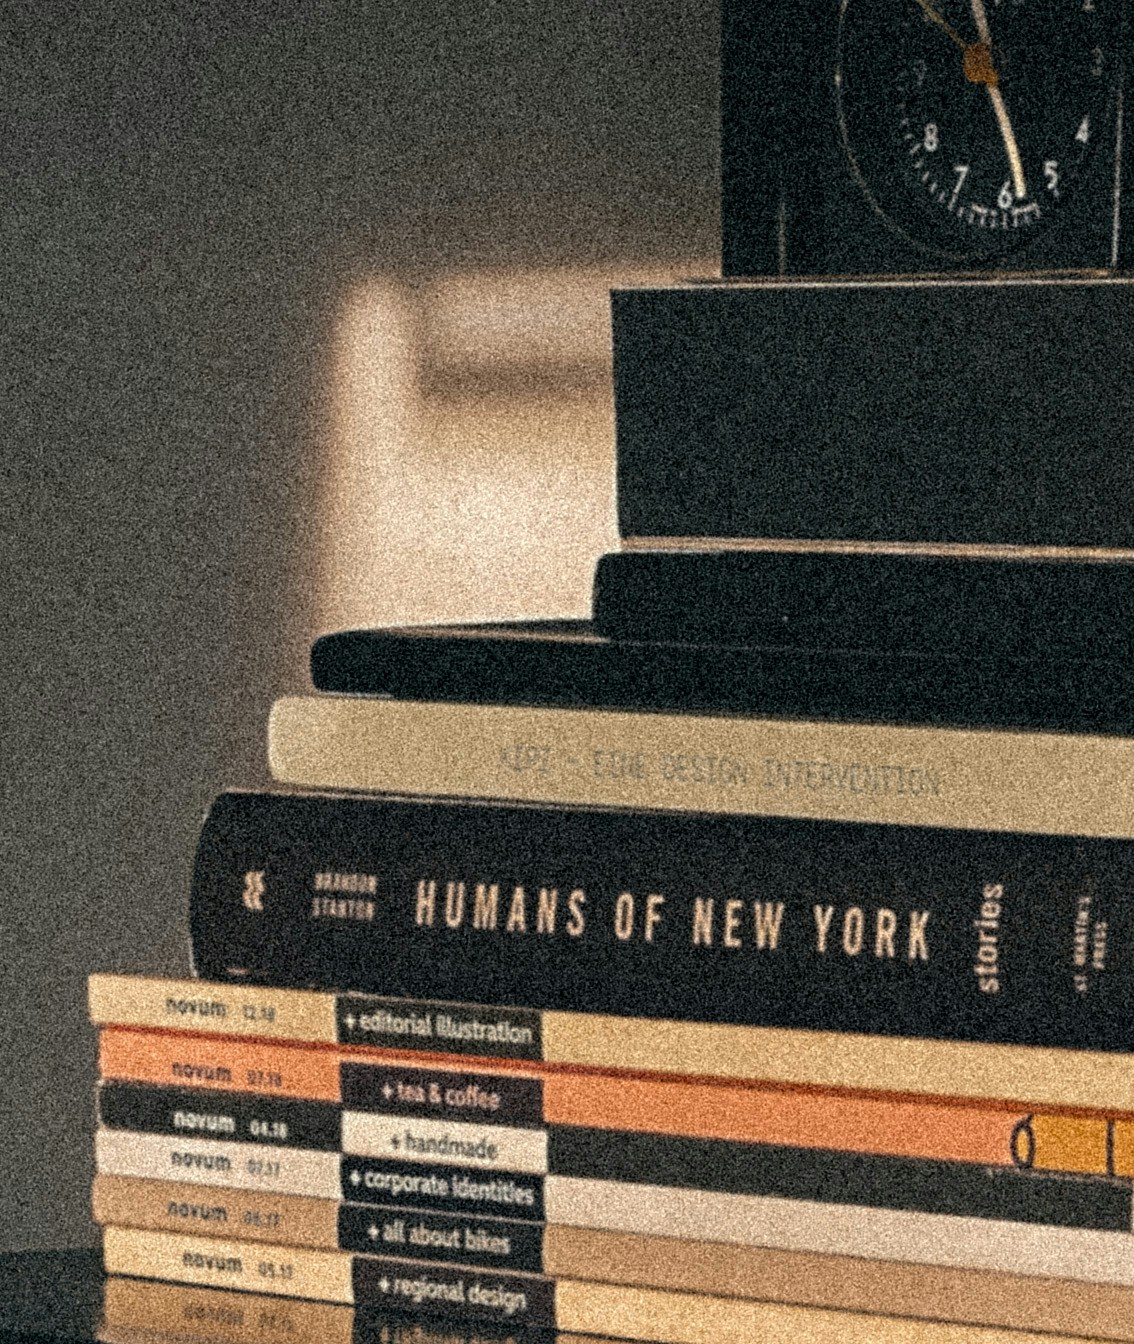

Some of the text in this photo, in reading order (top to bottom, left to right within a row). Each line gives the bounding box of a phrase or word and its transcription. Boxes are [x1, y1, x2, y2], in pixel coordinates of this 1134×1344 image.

[924, 122, 938, 151] 8
[1075, 114, 1091, 144] 4
[1044, 160, 1059, 190] 5
[997, 181, 1013, 209] 6
[661, 752, 748, 787] DESIGN
[763, 757, 941, 797] INTERVENTION
[314, 871, 379, 894] BRANDON
[311, 897, 376, 921] STANTON
[414, 878, 931, 962] HUMANS OF NEW YORK
[974, 882, 1004, 994] stories
[1093, 921, 1108, 971] PRESS
[166, 996, 227, 1018] novum
[359, 1010, 433, 1036] editorial
[435, 1014, 533, 1044] illustration
[171, 1060, 232, 1083] novum
[396, 1082, 426, 1104] tea
[429, 1084, 441, 1104] &
[445, 1085, 501, 1111] coffee
[173, 1110, 289, 1140] novum 04.18
[405, 1131, 497, 1160] handmade
[170, 1149, 231, 1173] novum
[364, 1170, 449, 1197] corporate
[452, 1175, 535, 1205] identities
[167, 1199, 228, 1223] novum
[382, 1221, 405, 1243] all
[409, 1222, 461, 1248] about
[465, 1226, 512, 1254] bikes
[182, 1251, 243, 1274] novum
[393, 1277, 465, 1304] regional
[468, 1284, 528, 1314] design
